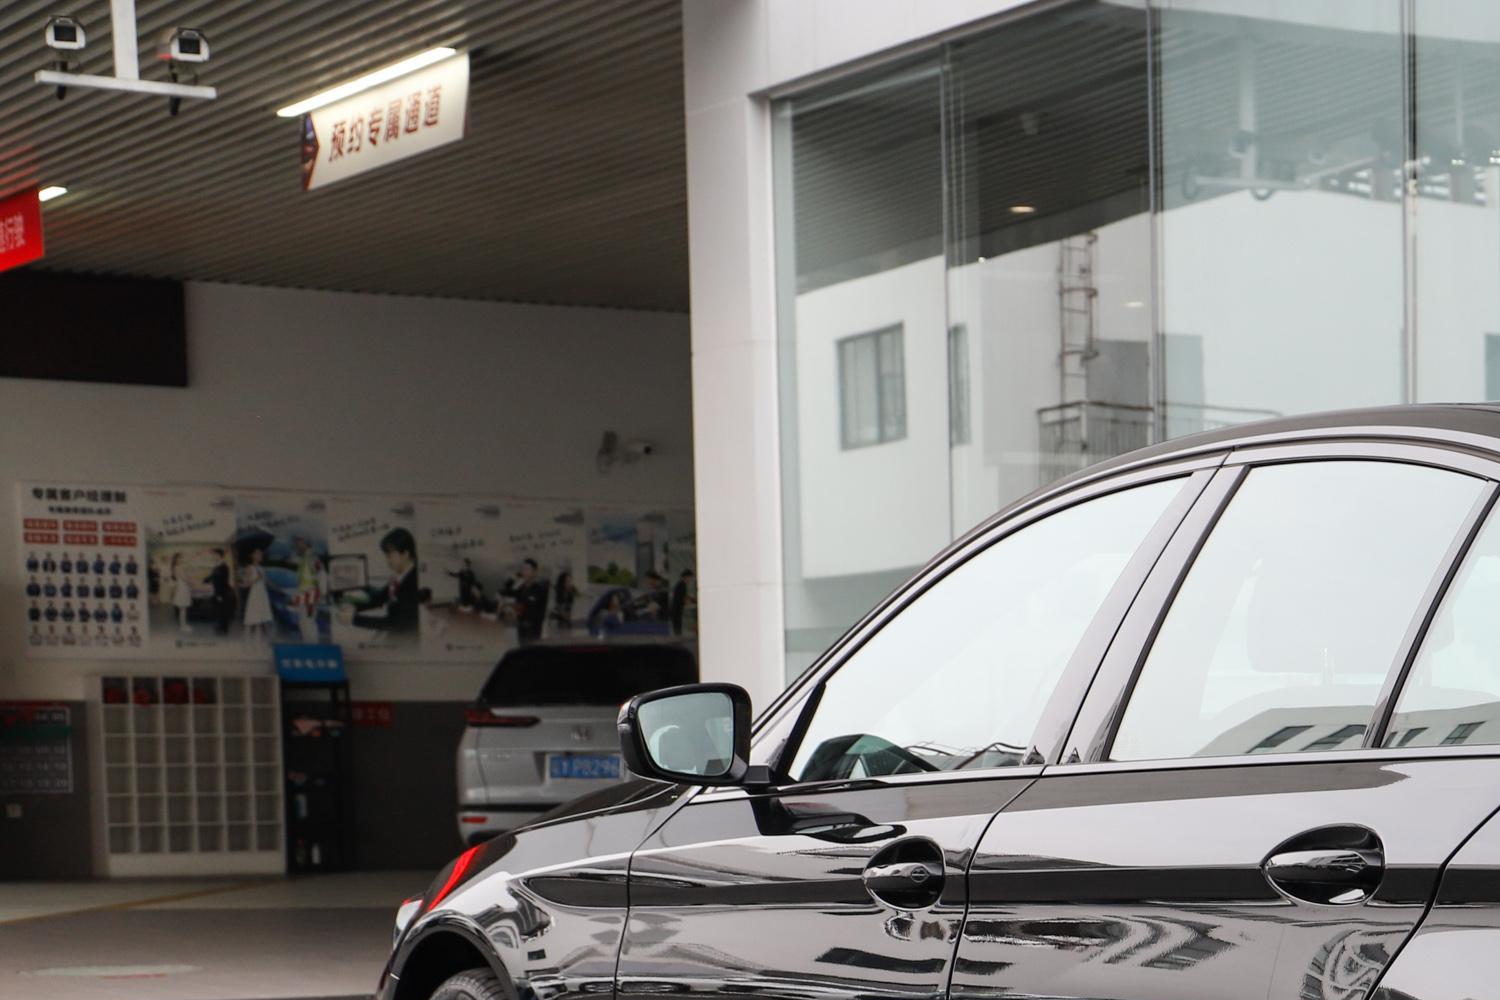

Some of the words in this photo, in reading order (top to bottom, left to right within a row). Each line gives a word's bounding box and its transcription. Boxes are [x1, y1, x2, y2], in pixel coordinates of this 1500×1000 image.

[328, 84, 442, 162] 预约专属通道
